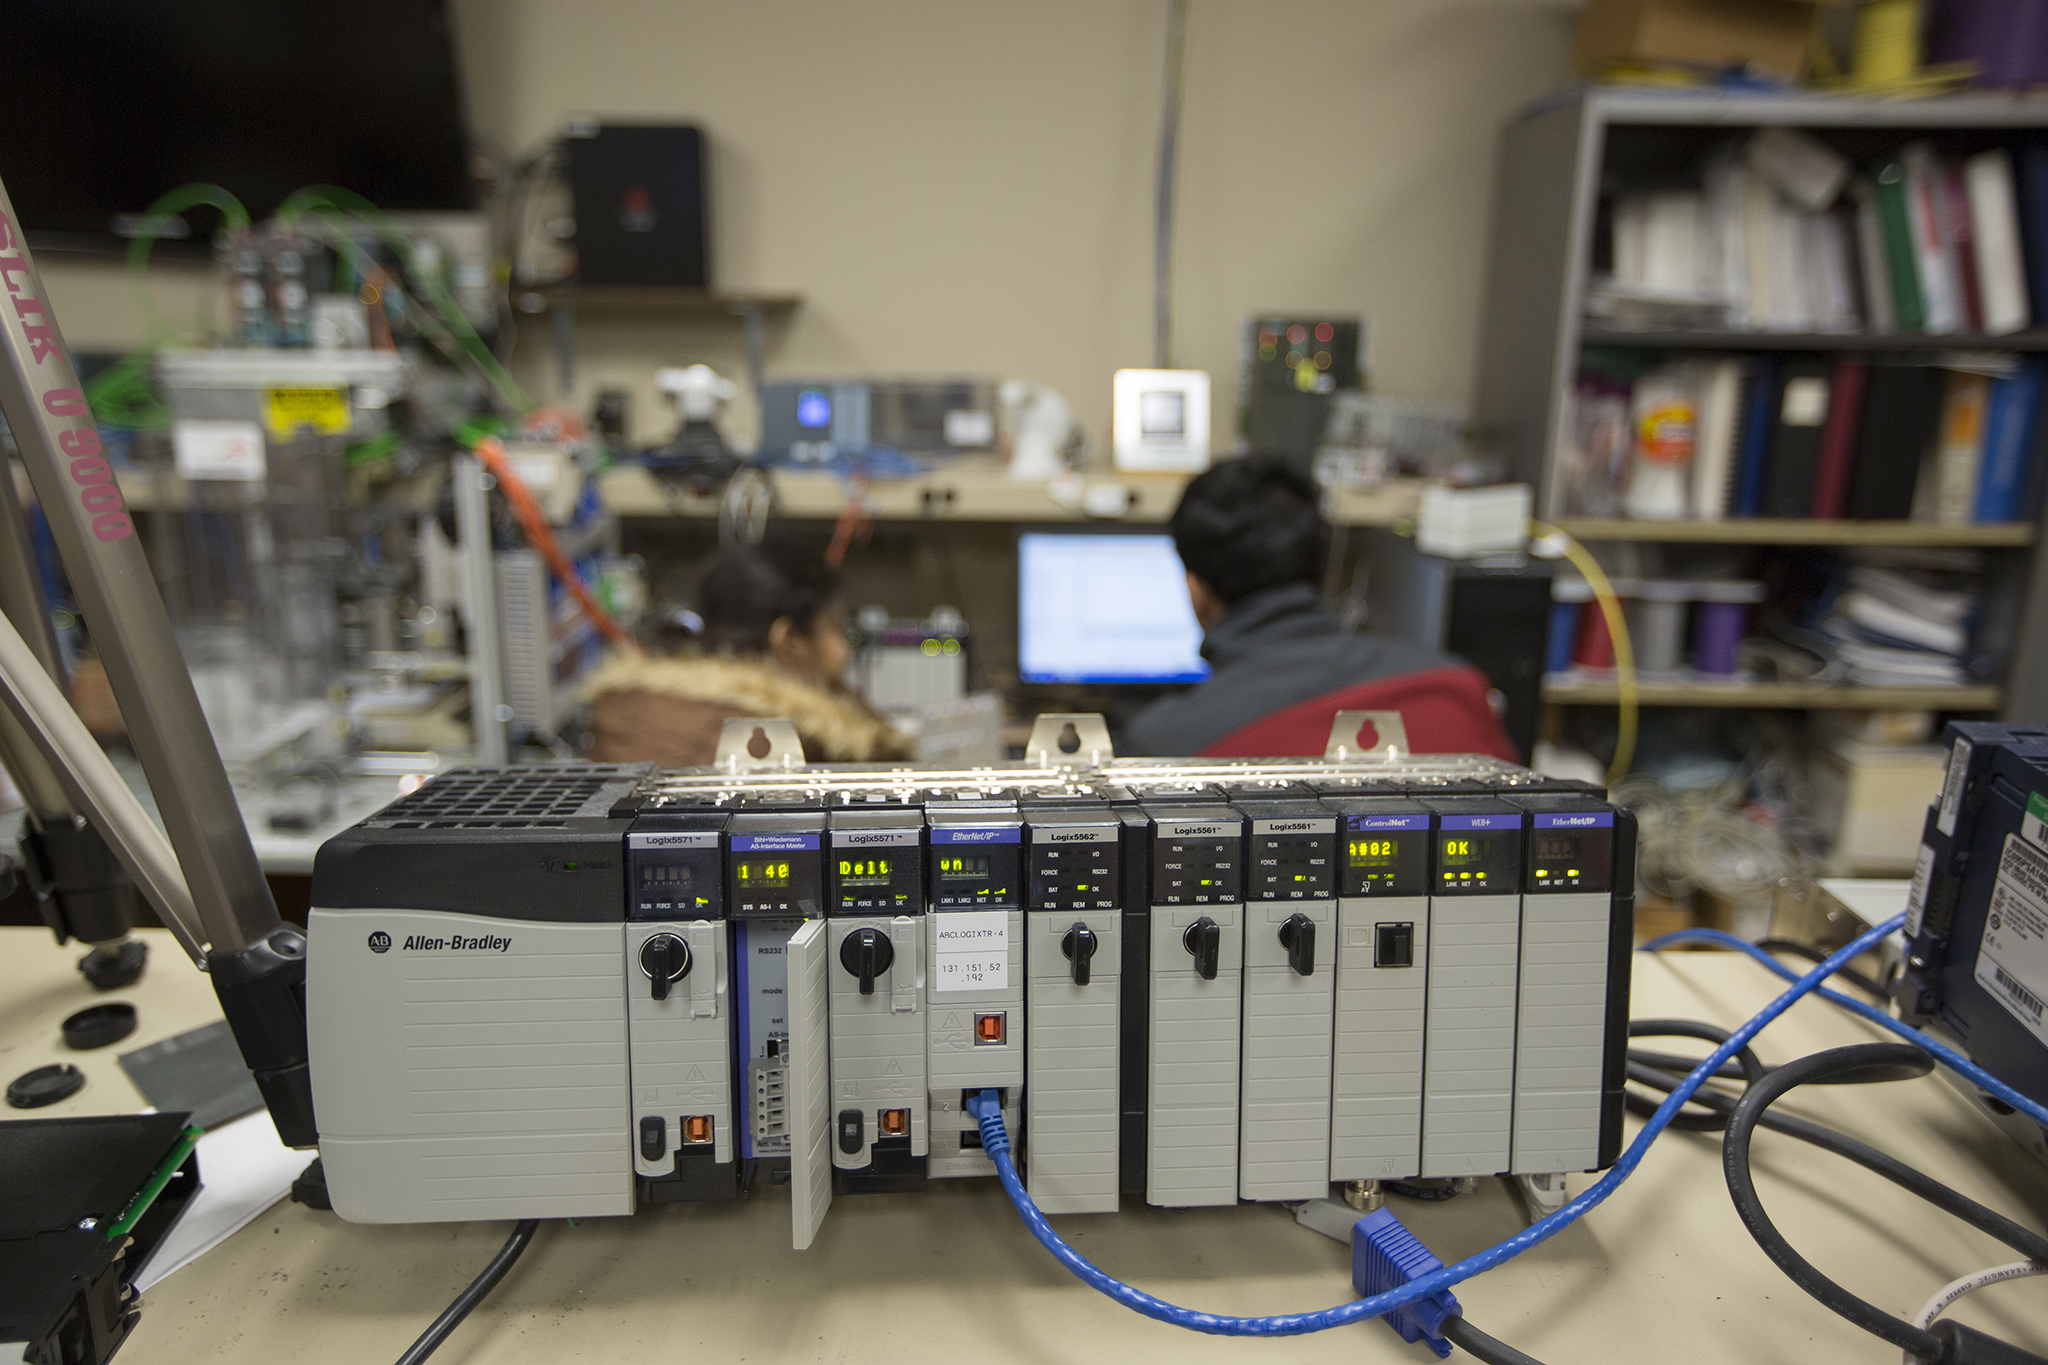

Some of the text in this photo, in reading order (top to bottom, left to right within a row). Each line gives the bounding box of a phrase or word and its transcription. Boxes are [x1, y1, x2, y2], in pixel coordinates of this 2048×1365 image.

[0, 209, 133, 542] SLIK U 9000
[1447, 841, 1469, 855] OK
[402, 935, 512, 952] Allen-Bradley
[943, 1102, 950, 1111] 2
[945, 1162, 995, 1171] EtherNet/I
